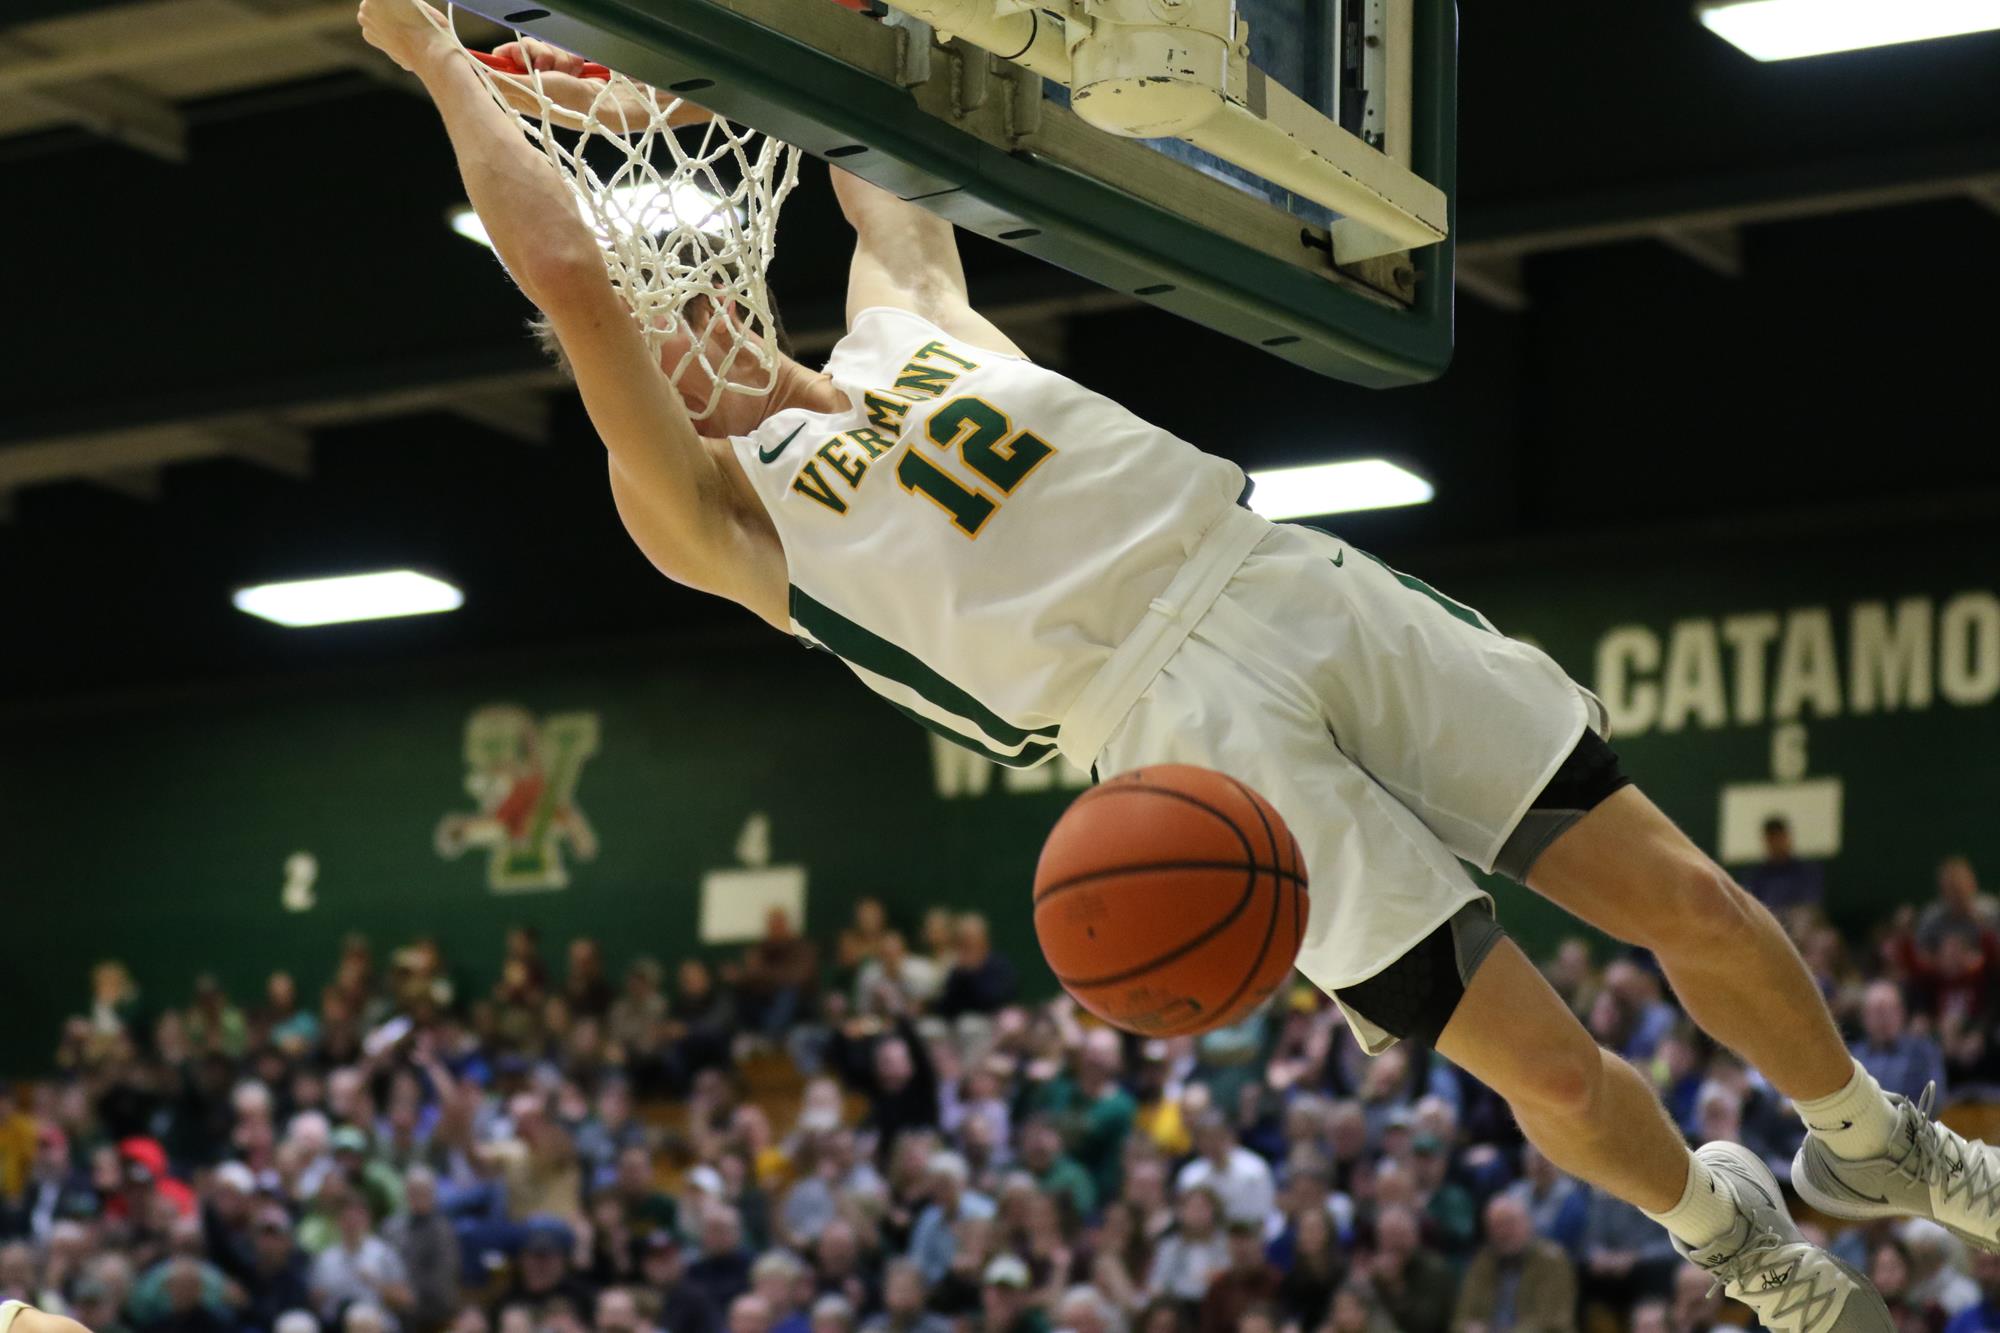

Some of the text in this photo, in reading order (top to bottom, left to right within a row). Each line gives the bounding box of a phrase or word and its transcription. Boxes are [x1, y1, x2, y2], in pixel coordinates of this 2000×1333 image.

[895, 394, 1059, 541] 12
[1594, 589, 2000, 737] CATAMO
[736, 812, 770, 869] 4
